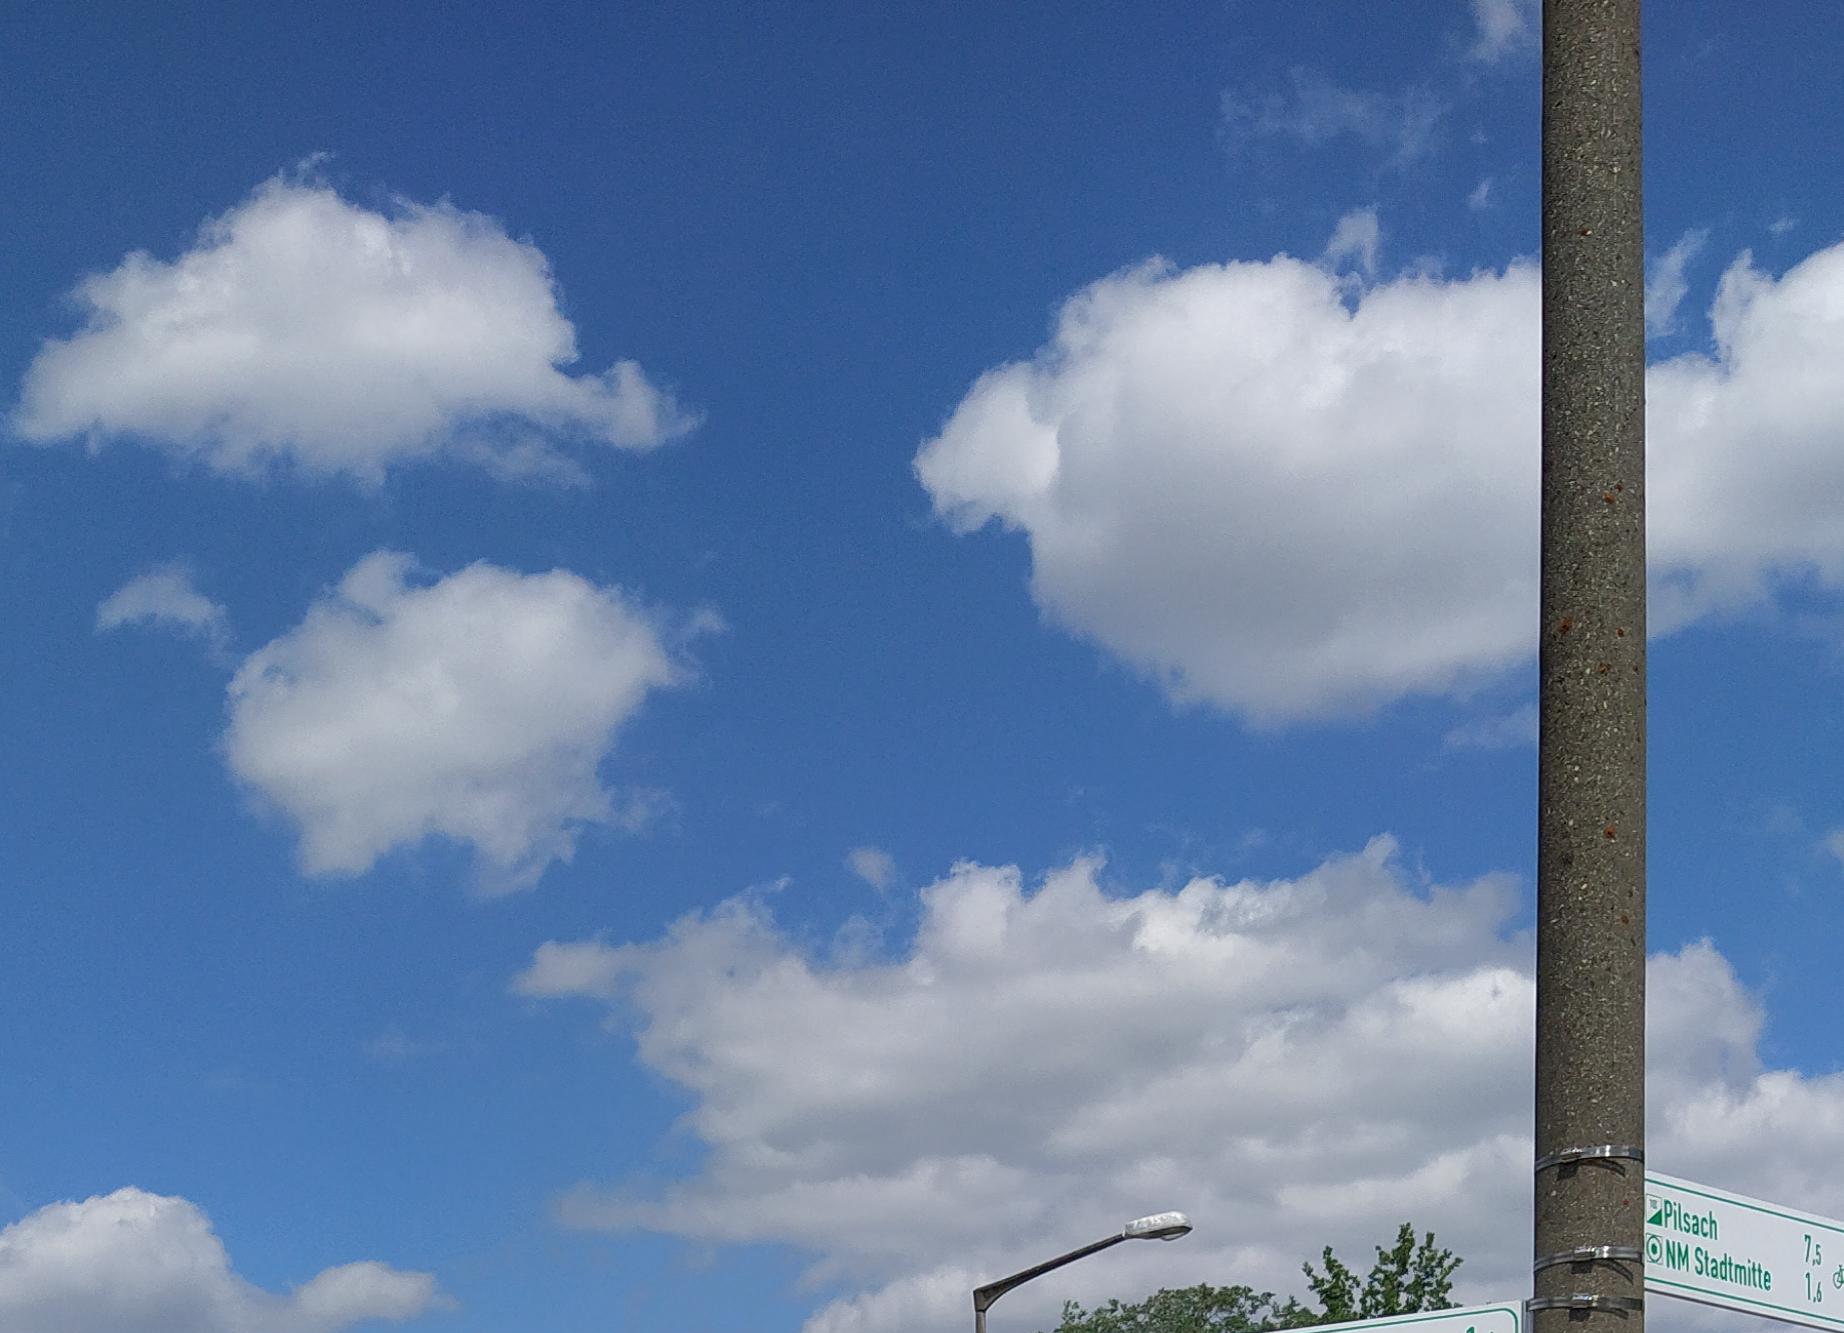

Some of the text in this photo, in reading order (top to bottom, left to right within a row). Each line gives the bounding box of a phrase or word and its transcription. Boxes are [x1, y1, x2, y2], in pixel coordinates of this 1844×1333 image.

[1663, 1199, 1822, 1266] Pilsach 7,5
[1665, 1239, 1823, 1303] NM Stadtmitte 1,6
